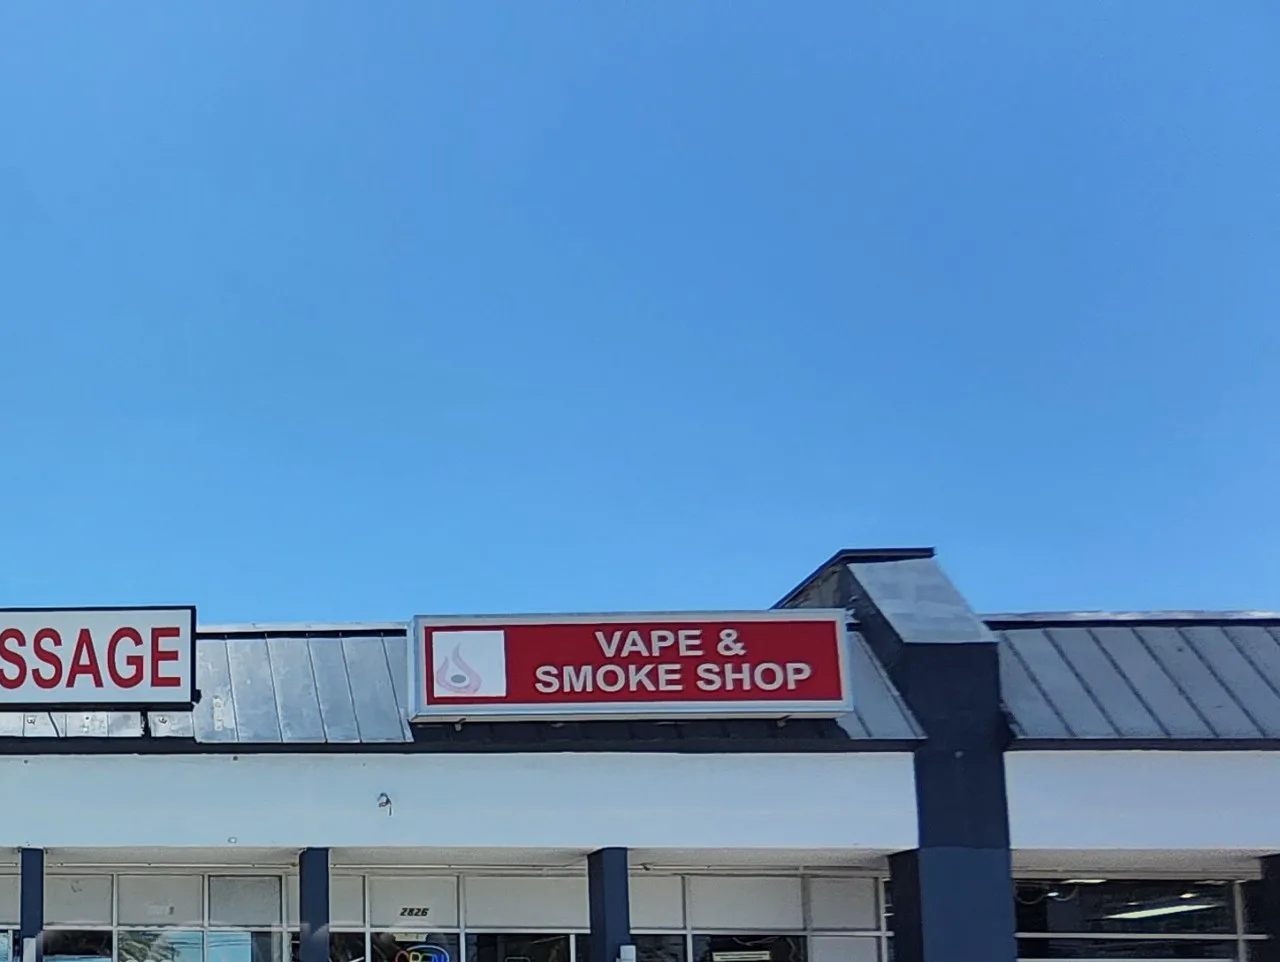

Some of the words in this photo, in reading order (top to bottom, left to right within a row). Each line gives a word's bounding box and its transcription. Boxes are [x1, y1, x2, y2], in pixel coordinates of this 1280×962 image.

[595, 629, 704, 657] VAPE
[716, 628, 747, 656] &
[535, 663, 683, 692] SMOKE
[695, 662, 812, 691] SHOP
[400, 907, 429, 917] 2826
